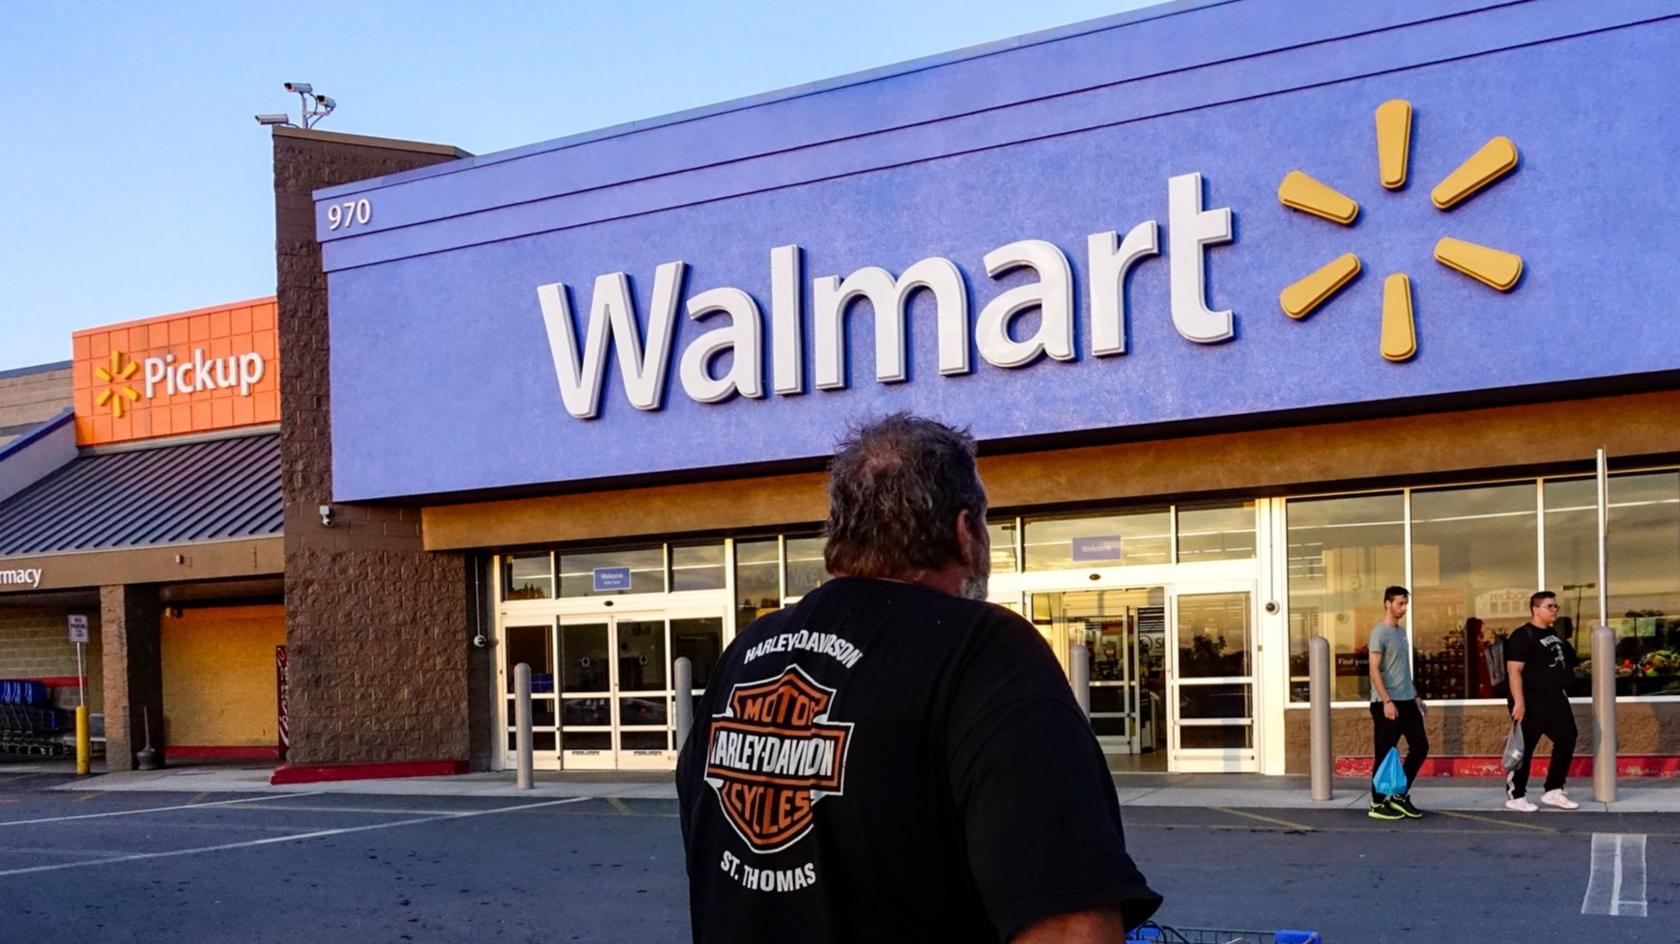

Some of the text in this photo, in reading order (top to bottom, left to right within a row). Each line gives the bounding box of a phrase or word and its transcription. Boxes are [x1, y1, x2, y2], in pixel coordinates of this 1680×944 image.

[328, 199, 371, 230] 970
[537, 172, 1234, 418] Walmart
[145, 348, 264, 398] Pickup
[731, 783, 811, 834] CYCLES
[721, 850, 816, 892] ST. THOMAS
